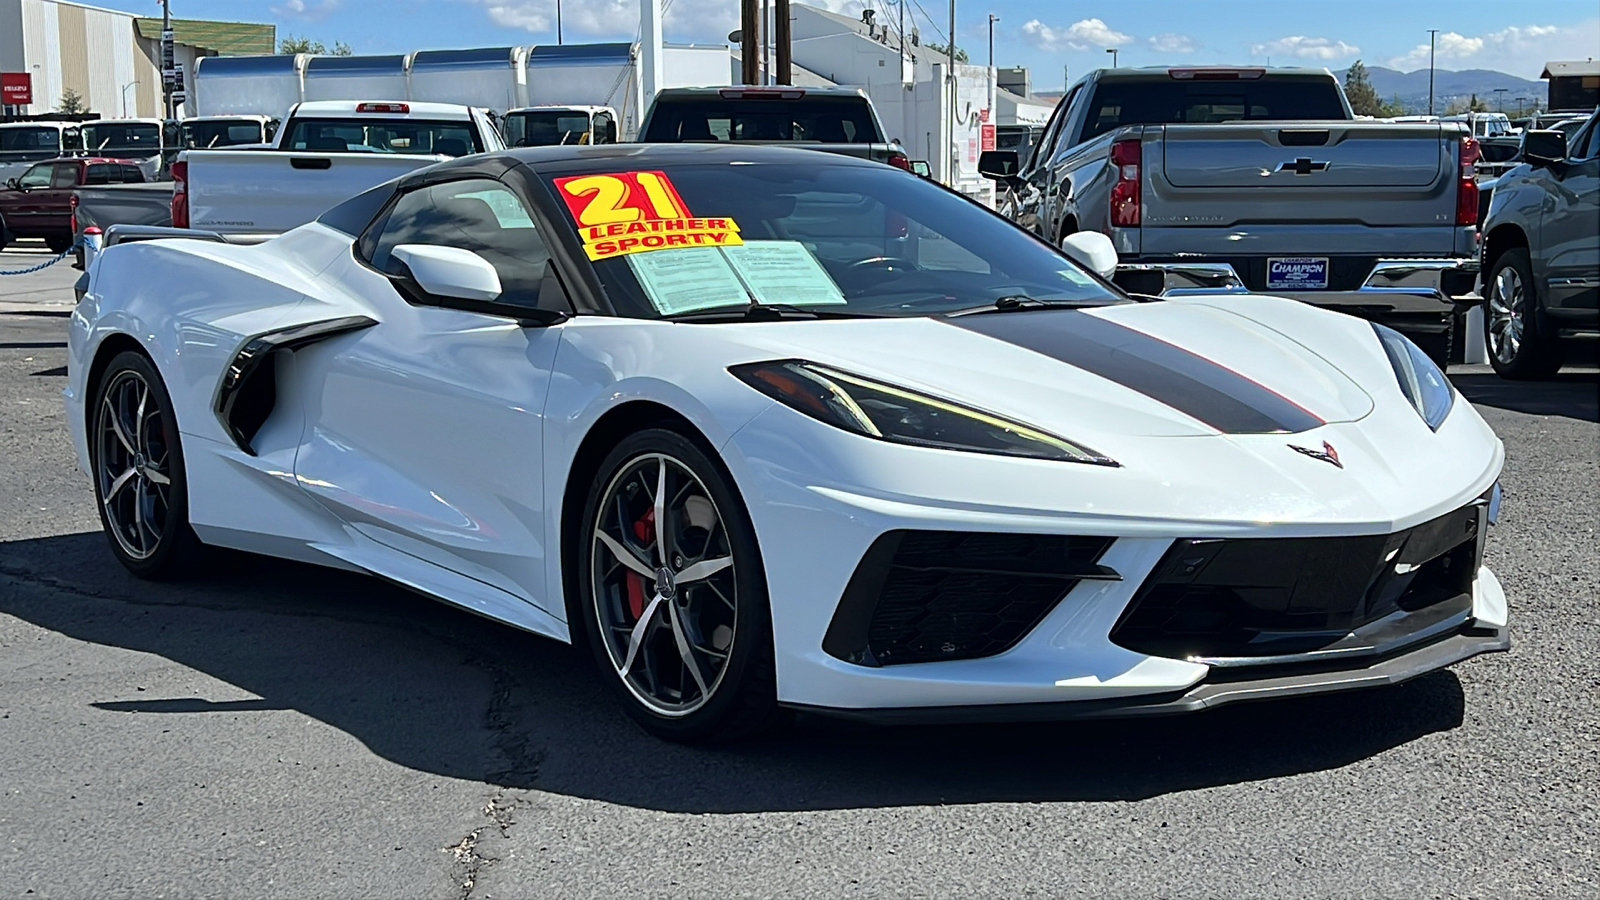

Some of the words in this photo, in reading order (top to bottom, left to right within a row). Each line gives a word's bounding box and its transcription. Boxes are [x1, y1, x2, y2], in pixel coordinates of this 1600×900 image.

[564, 172, 683, 226] 21
[590, 219, 728, 240] LEATHER
[594, 232, 729, 256] SPORTY
[1272, 262, 1324, 273] CHAMPION
